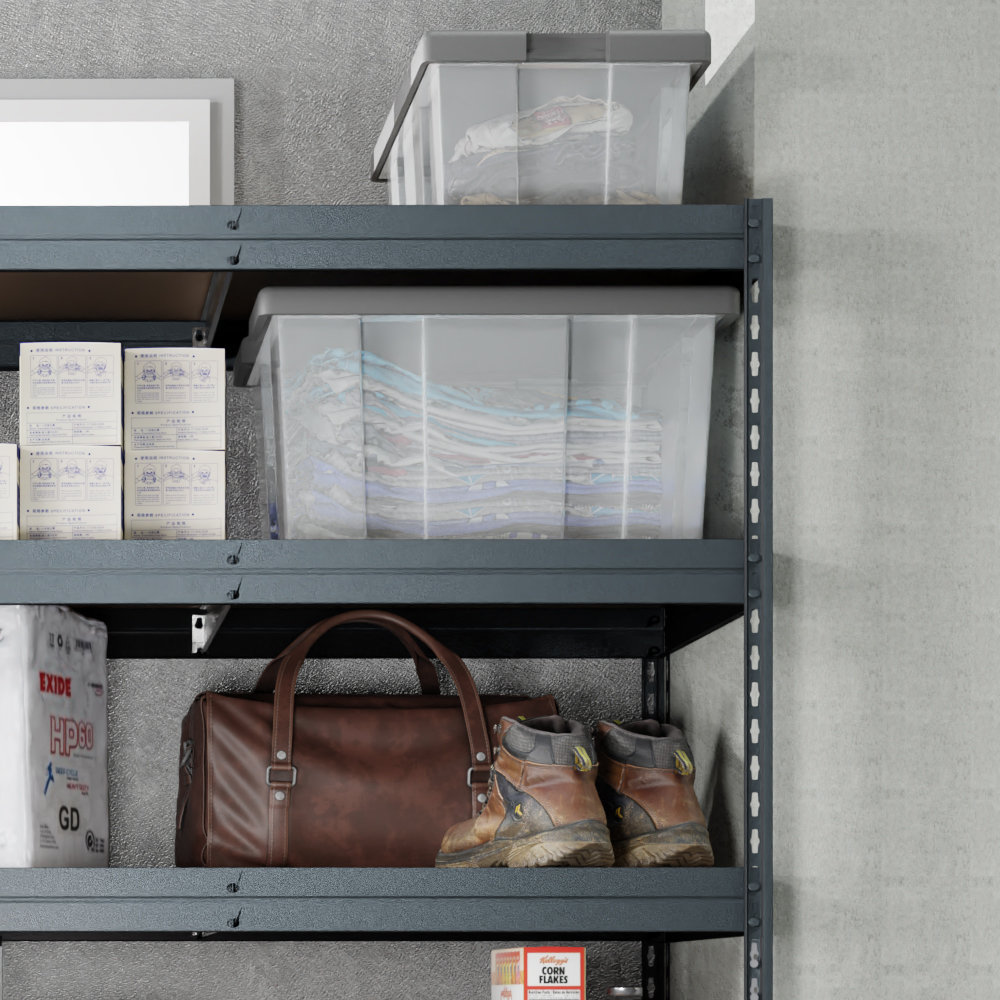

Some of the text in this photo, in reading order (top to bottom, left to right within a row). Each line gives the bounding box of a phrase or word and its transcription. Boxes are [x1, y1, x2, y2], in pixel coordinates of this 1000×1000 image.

[39, 671, 71, 698] EXIDE
[50, 715, 94, 757] HP60
[59, 806, 80, 831] GD
[542, 967, 565, 975] CORN
